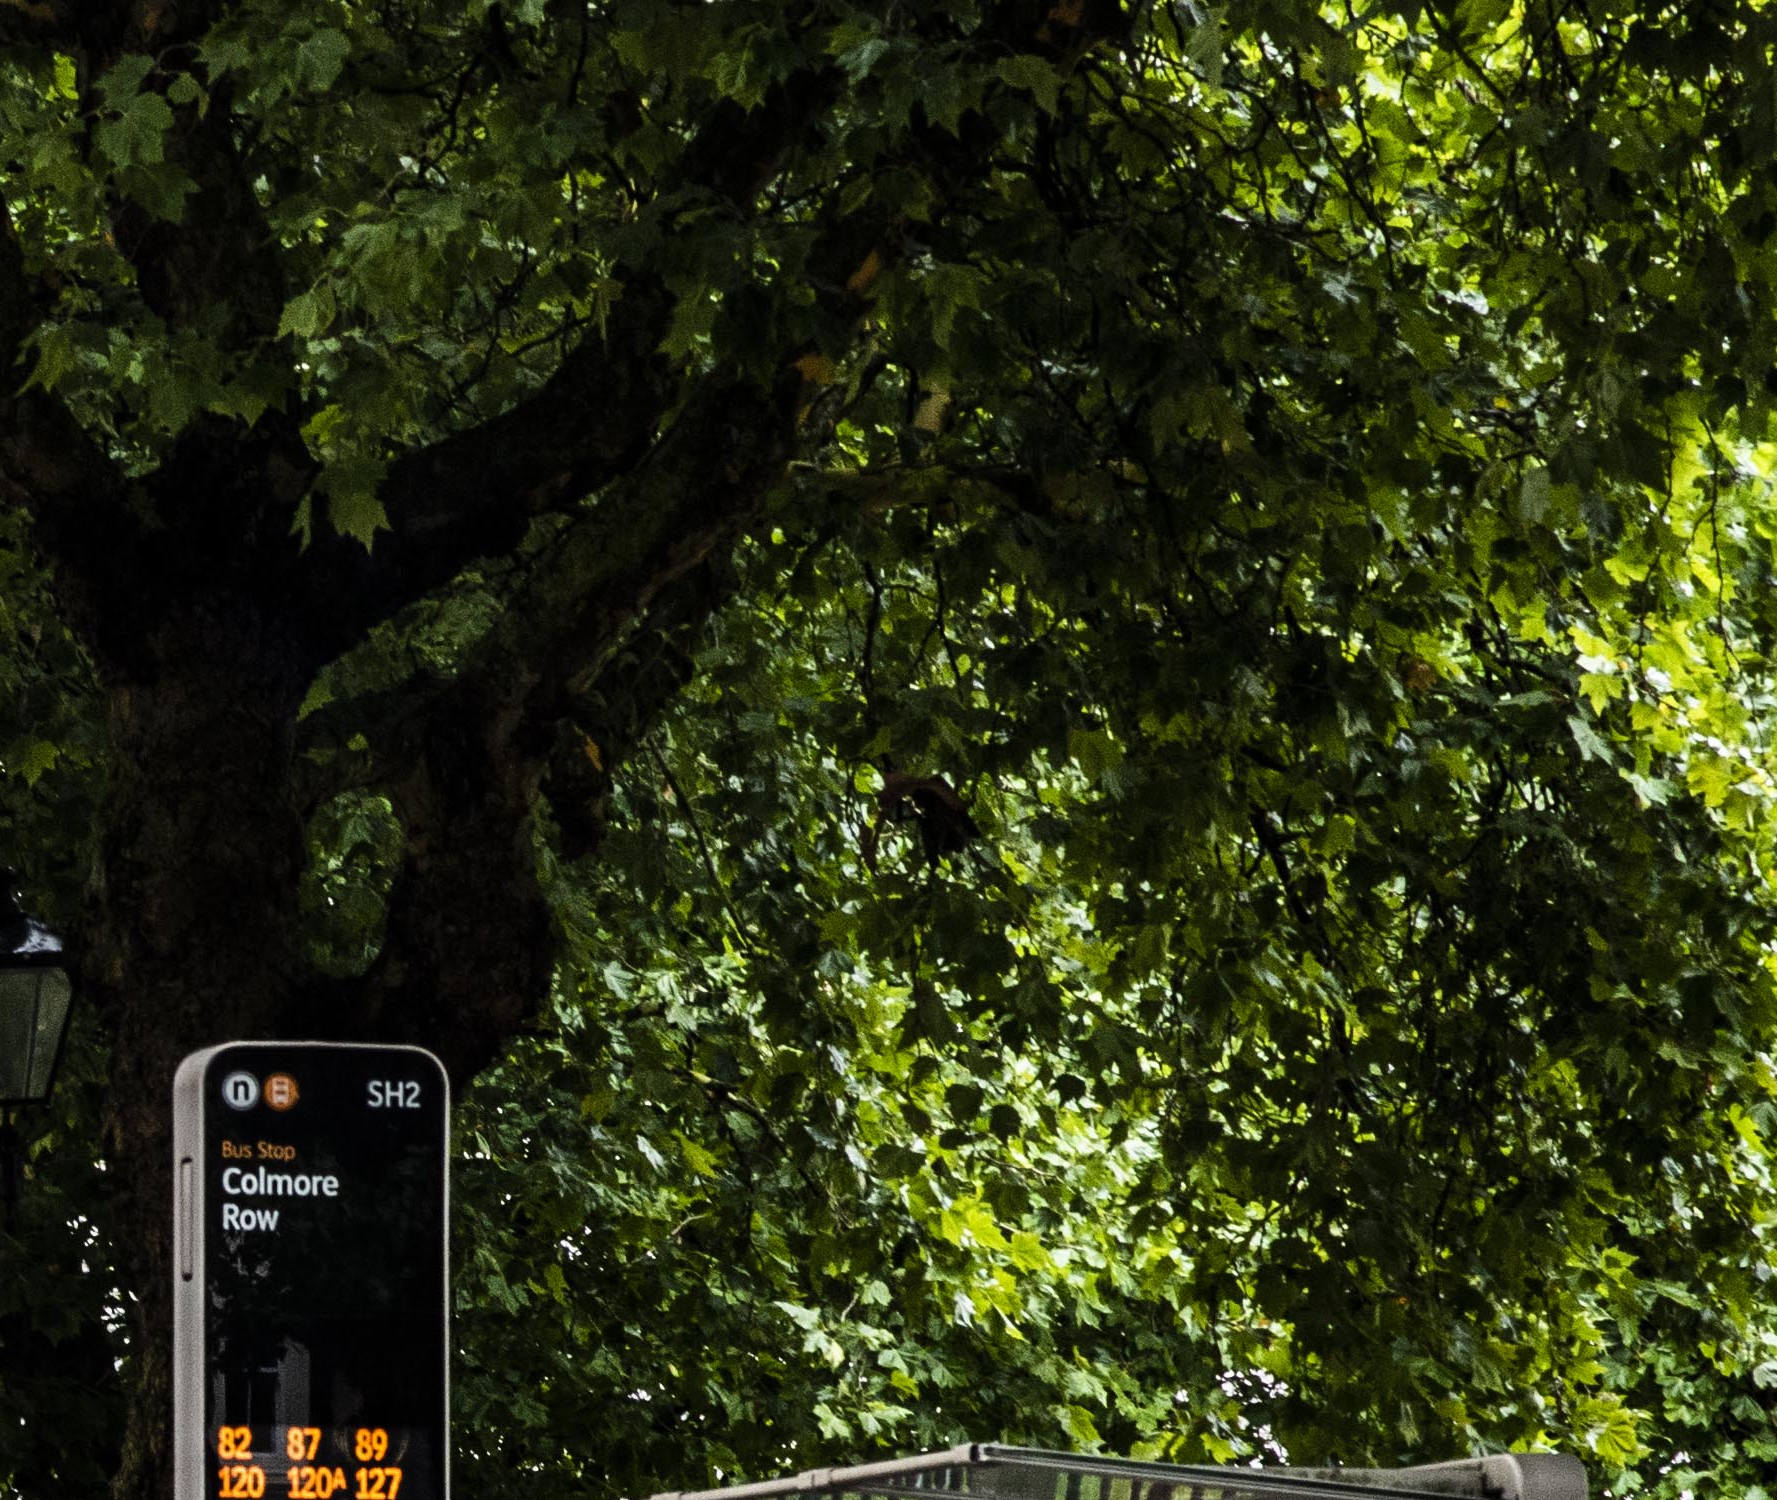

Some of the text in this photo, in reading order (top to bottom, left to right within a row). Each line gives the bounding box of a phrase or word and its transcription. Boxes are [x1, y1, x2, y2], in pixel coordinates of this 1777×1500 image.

[367, 1080, 421, 1108] SH2
[222, 1140, 296, 1162] Bus Stop
[222, 1166, 339, 1197] Colmore
[222, 1203, 279, 1232] Row
[218, 1425, 388, 1462] 82 87 89
[218, 1466, 403, 1500] 120 120A 127
